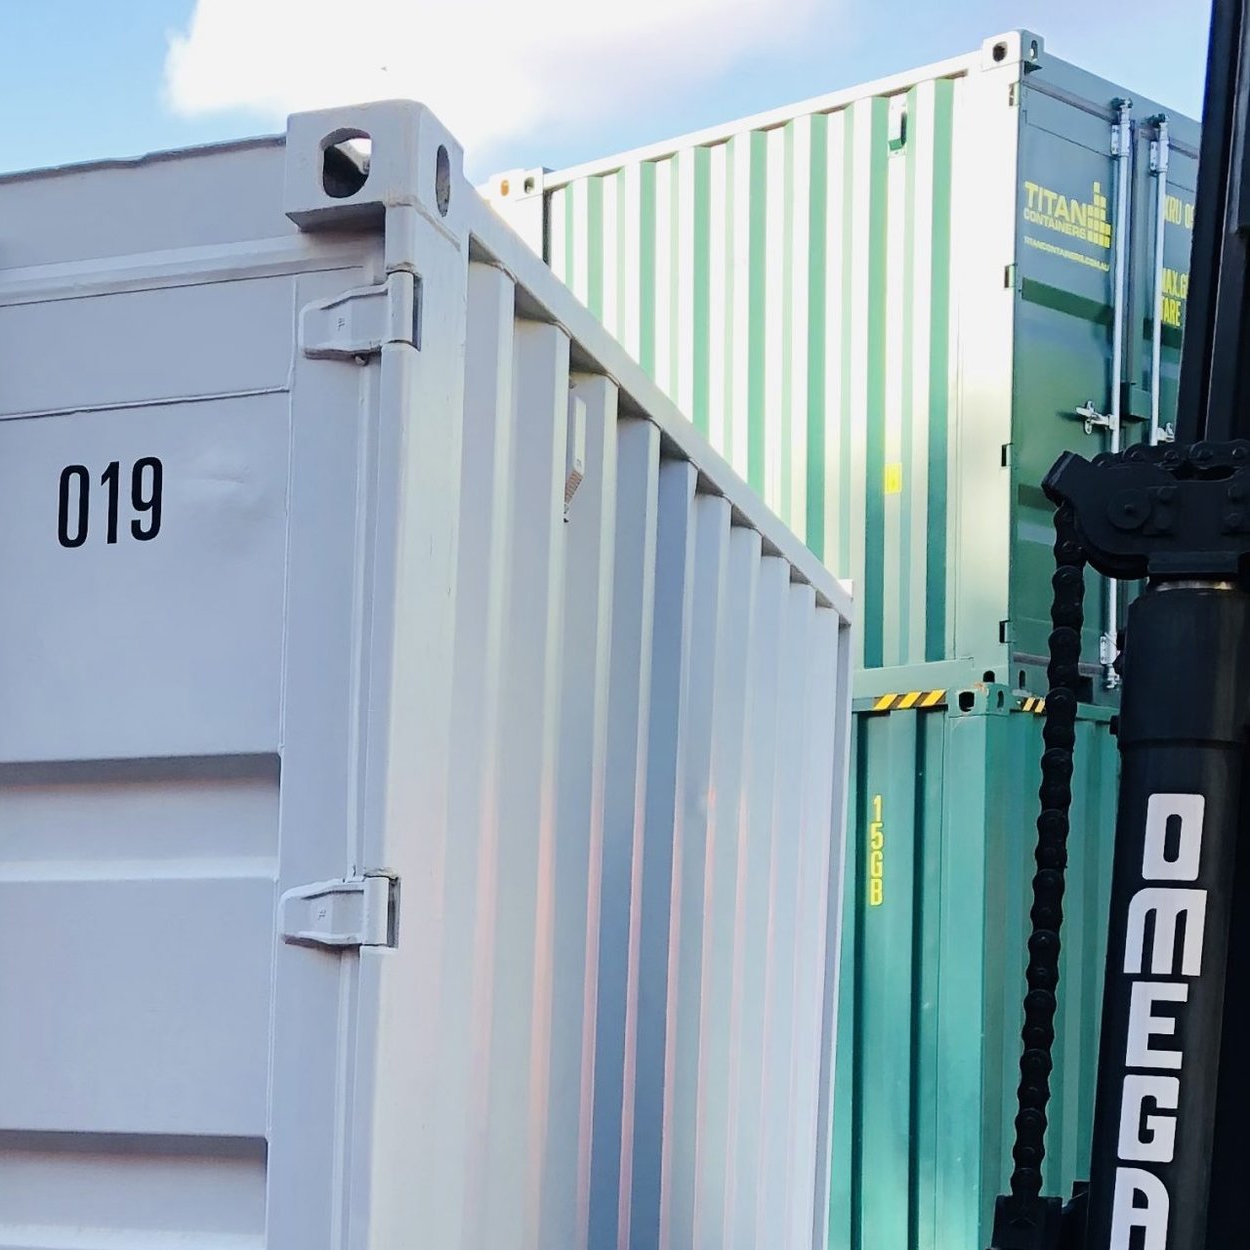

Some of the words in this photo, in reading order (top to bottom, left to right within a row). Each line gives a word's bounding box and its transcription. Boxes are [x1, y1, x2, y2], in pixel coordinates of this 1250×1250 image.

[1023, 207, 1087, 240] CONTAINERS
[1024, 181, 1088, 227] TITAN
[58, 456, 163, 548] 019
